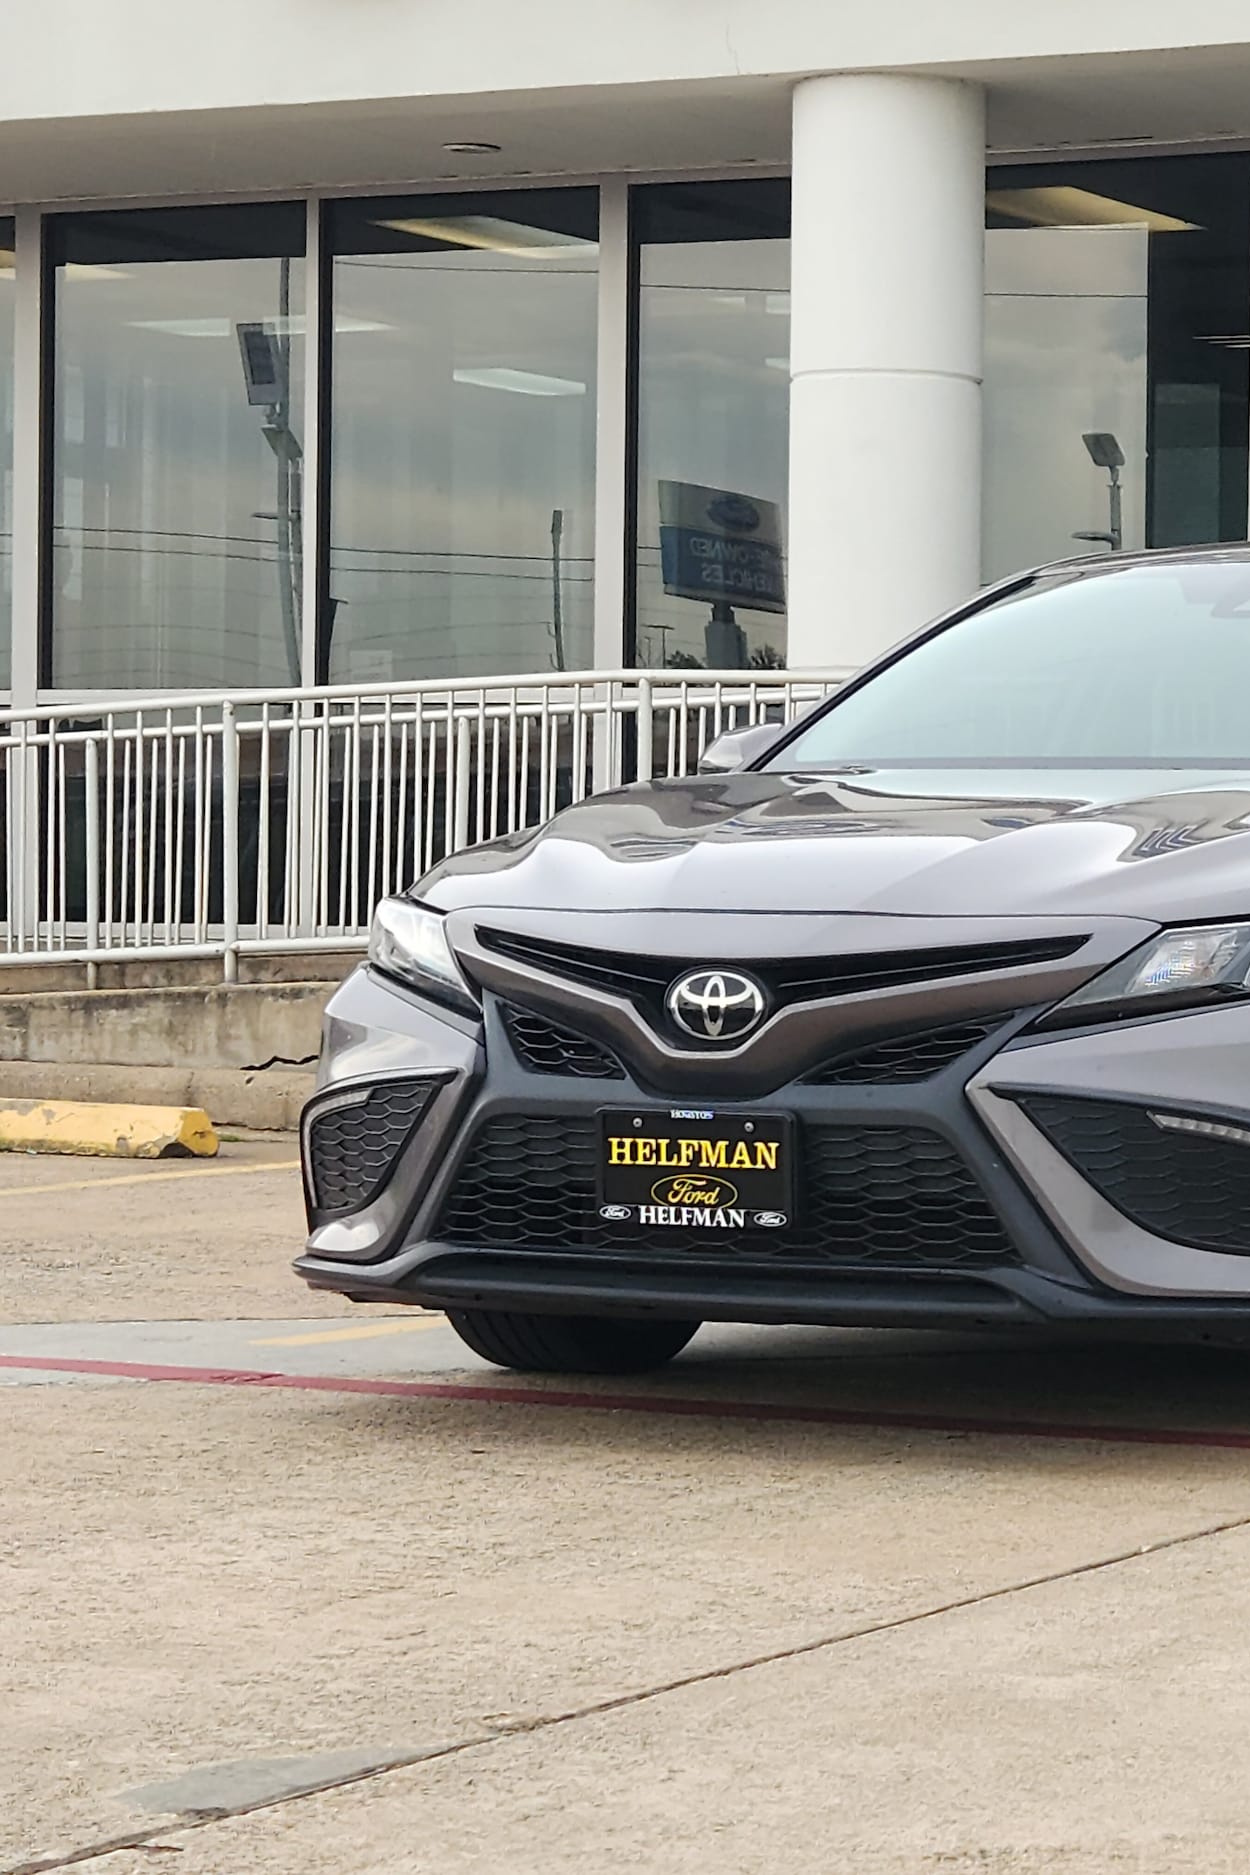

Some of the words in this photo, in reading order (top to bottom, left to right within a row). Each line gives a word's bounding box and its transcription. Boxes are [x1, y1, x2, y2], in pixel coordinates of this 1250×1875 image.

[607, 1137, 780, 1170] HELFMAN
[667, 1178, 721, 1205] Ford
[639, 1204, 745, 1229] HELFMAN
